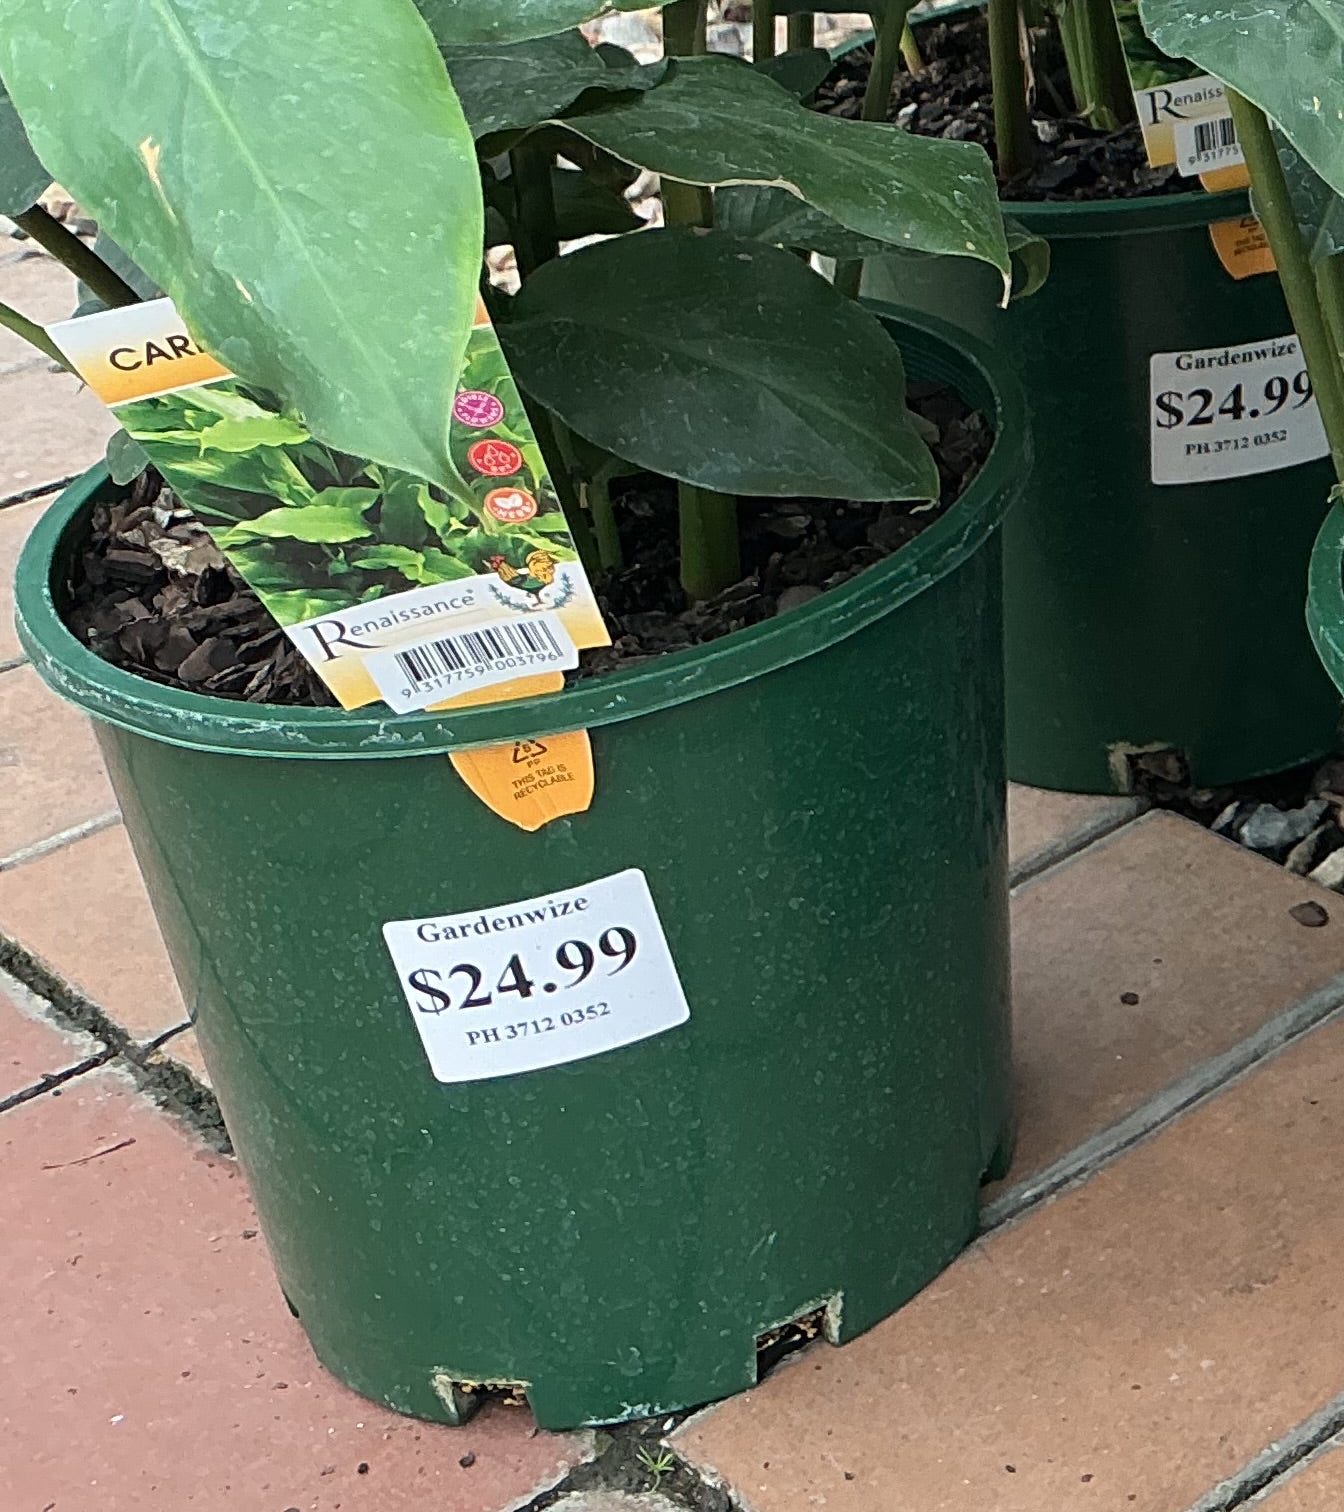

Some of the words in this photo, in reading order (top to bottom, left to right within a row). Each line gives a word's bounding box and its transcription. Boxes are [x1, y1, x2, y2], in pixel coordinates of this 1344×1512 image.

[109, 334, 205, 372] CAR
[1175, 341, 1297, 372] Gardenwize
[1155, 369, 1313, 430] $24.99
[1214, 437, 1249, 454] 3712
[1254, 429, 1288, 447] 0352
[304, 594, 475, 663] Renaissance
[416, 895, 590, 943] Gardenwize
[407, 925, 637, 1016] $24.99
[465, 1028, 500, 1046] PH
[506, 1016, 556, 1040] 3712
[560, 1001, 611, 1028] 0352
